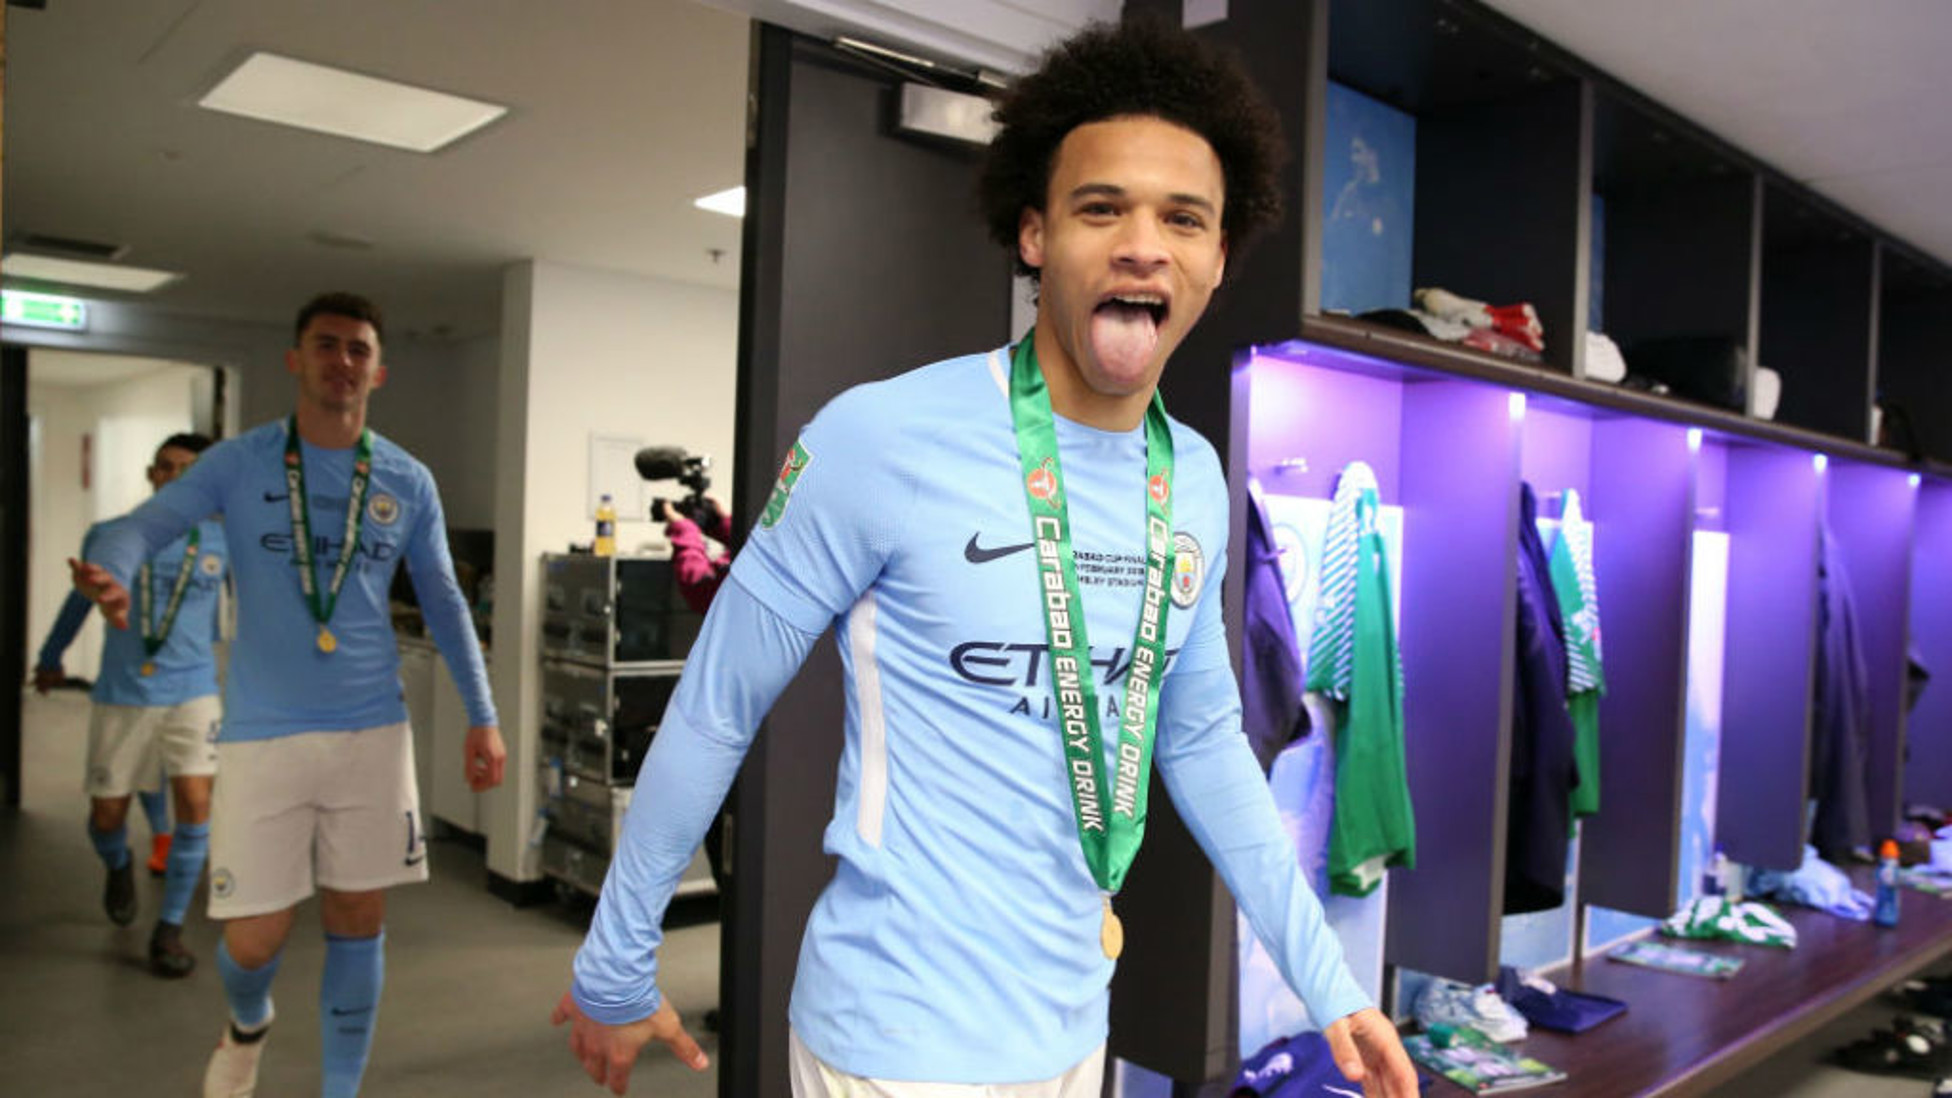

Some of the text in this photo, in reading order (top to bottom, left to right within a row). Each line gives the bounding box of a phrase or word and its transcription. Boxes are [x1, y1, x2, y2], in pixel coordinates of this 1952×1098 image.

[1035, 515, 1104, 832] Carabao ENERGY DRINK
[1124, 646, 1155, 741] ENERGY
[1112, 743, 1142, 820] DRINK
